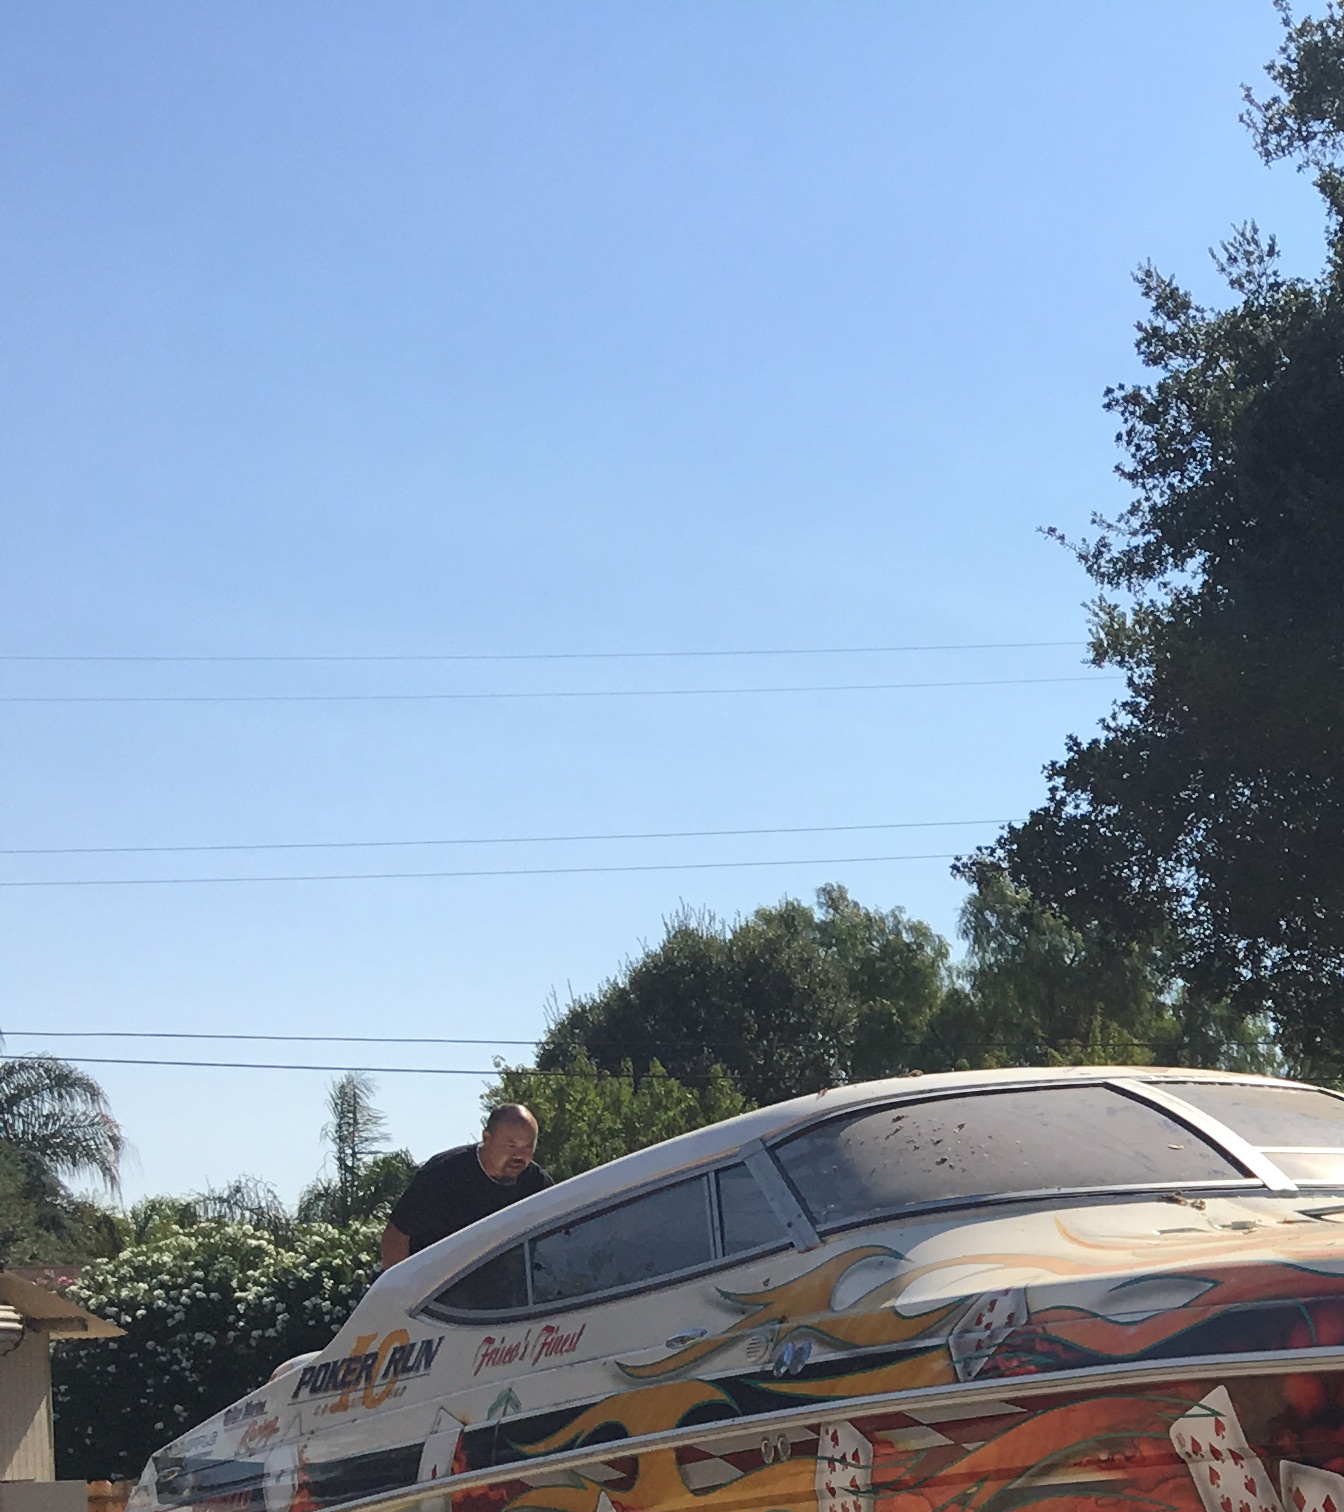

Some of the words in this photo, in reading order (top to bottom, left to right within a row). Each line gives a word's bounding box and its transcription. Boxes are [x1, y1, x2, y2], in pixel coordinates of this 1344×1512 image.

[291, 1351, 380, 1399] POKER
[381, 1335, 446, 1380] RUN
[530, 1322, 587, 1367] Finest
